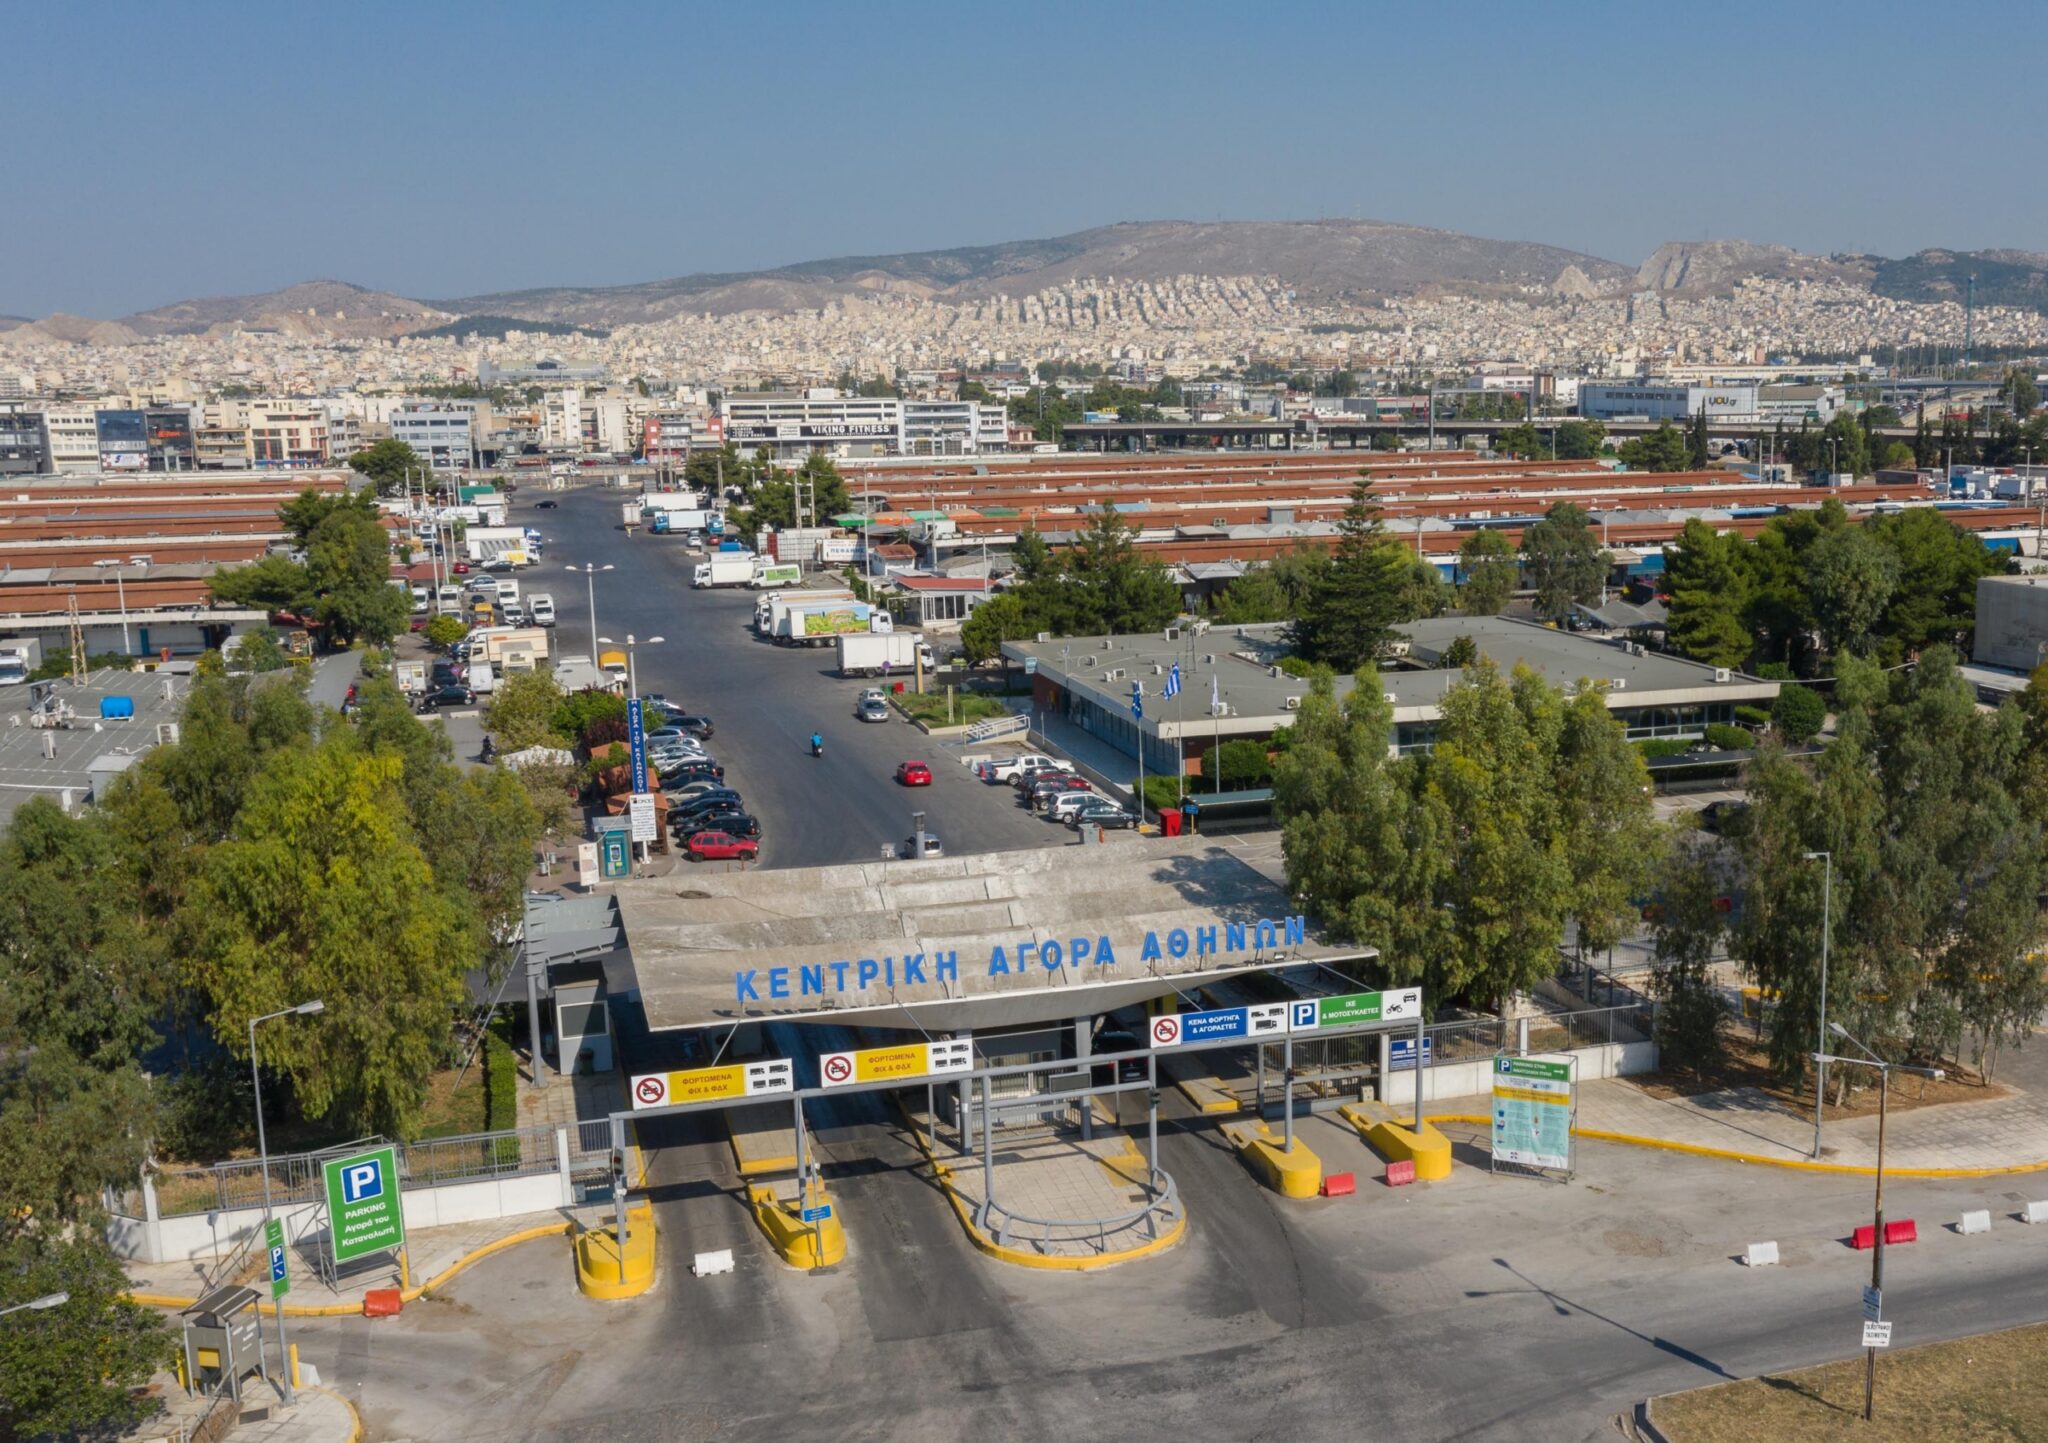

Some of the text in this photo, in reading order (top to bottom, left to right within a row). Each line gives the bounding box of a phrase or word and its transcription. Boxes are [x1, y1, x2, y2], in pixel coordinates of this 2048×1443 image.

[811, 424, 890, 434] VIKING FITNESS
[736, 950, 958, 1003] ΚΕΝΤΡΙΚΗ
[988, 935, 1116, 977] ΑΓΟΡΑ
[1140, 915, 1305, 961] ΑΘΗΝΩΝ
[1298, 1005, 1312, 1025] P
[1328, 1007, 1380, 1018] ΜΟΤΟΣΥΚΛΕΤΕΣ
[1188, 1014, 1240, 1026] ΚΕΝΑ ΦΟΡΤΗΓΑ
[1198, 1023, 1238, 1033] ΑΓΟΡΑΣΤΕΣ
[868, 1052, 916, 1064] ΦΟΡΤΩΜΕΝΑ
[873, 1065, 887, 1073] ΦΙΧ
[895, 1063, 912, 1071] ΦΔΧ
[1501, 1060, 1510, 1072] P
[682, 1074, 733, 1085] ΦΟΡΤΩΜΕΝΑ
[688, 1087, 702, 1095] ΦΙΧ
[711, 1084, 728, 1093] ΦΔΧ
[350, 1165, 376, 1200] P
[345, 1202, 386, 1219] PARKING
[345, 1215, 390, 1233] Αγορά του
[342, 1225, 395, 1247] Καταναλωτή
[272, 1247, 282, 1263] P
